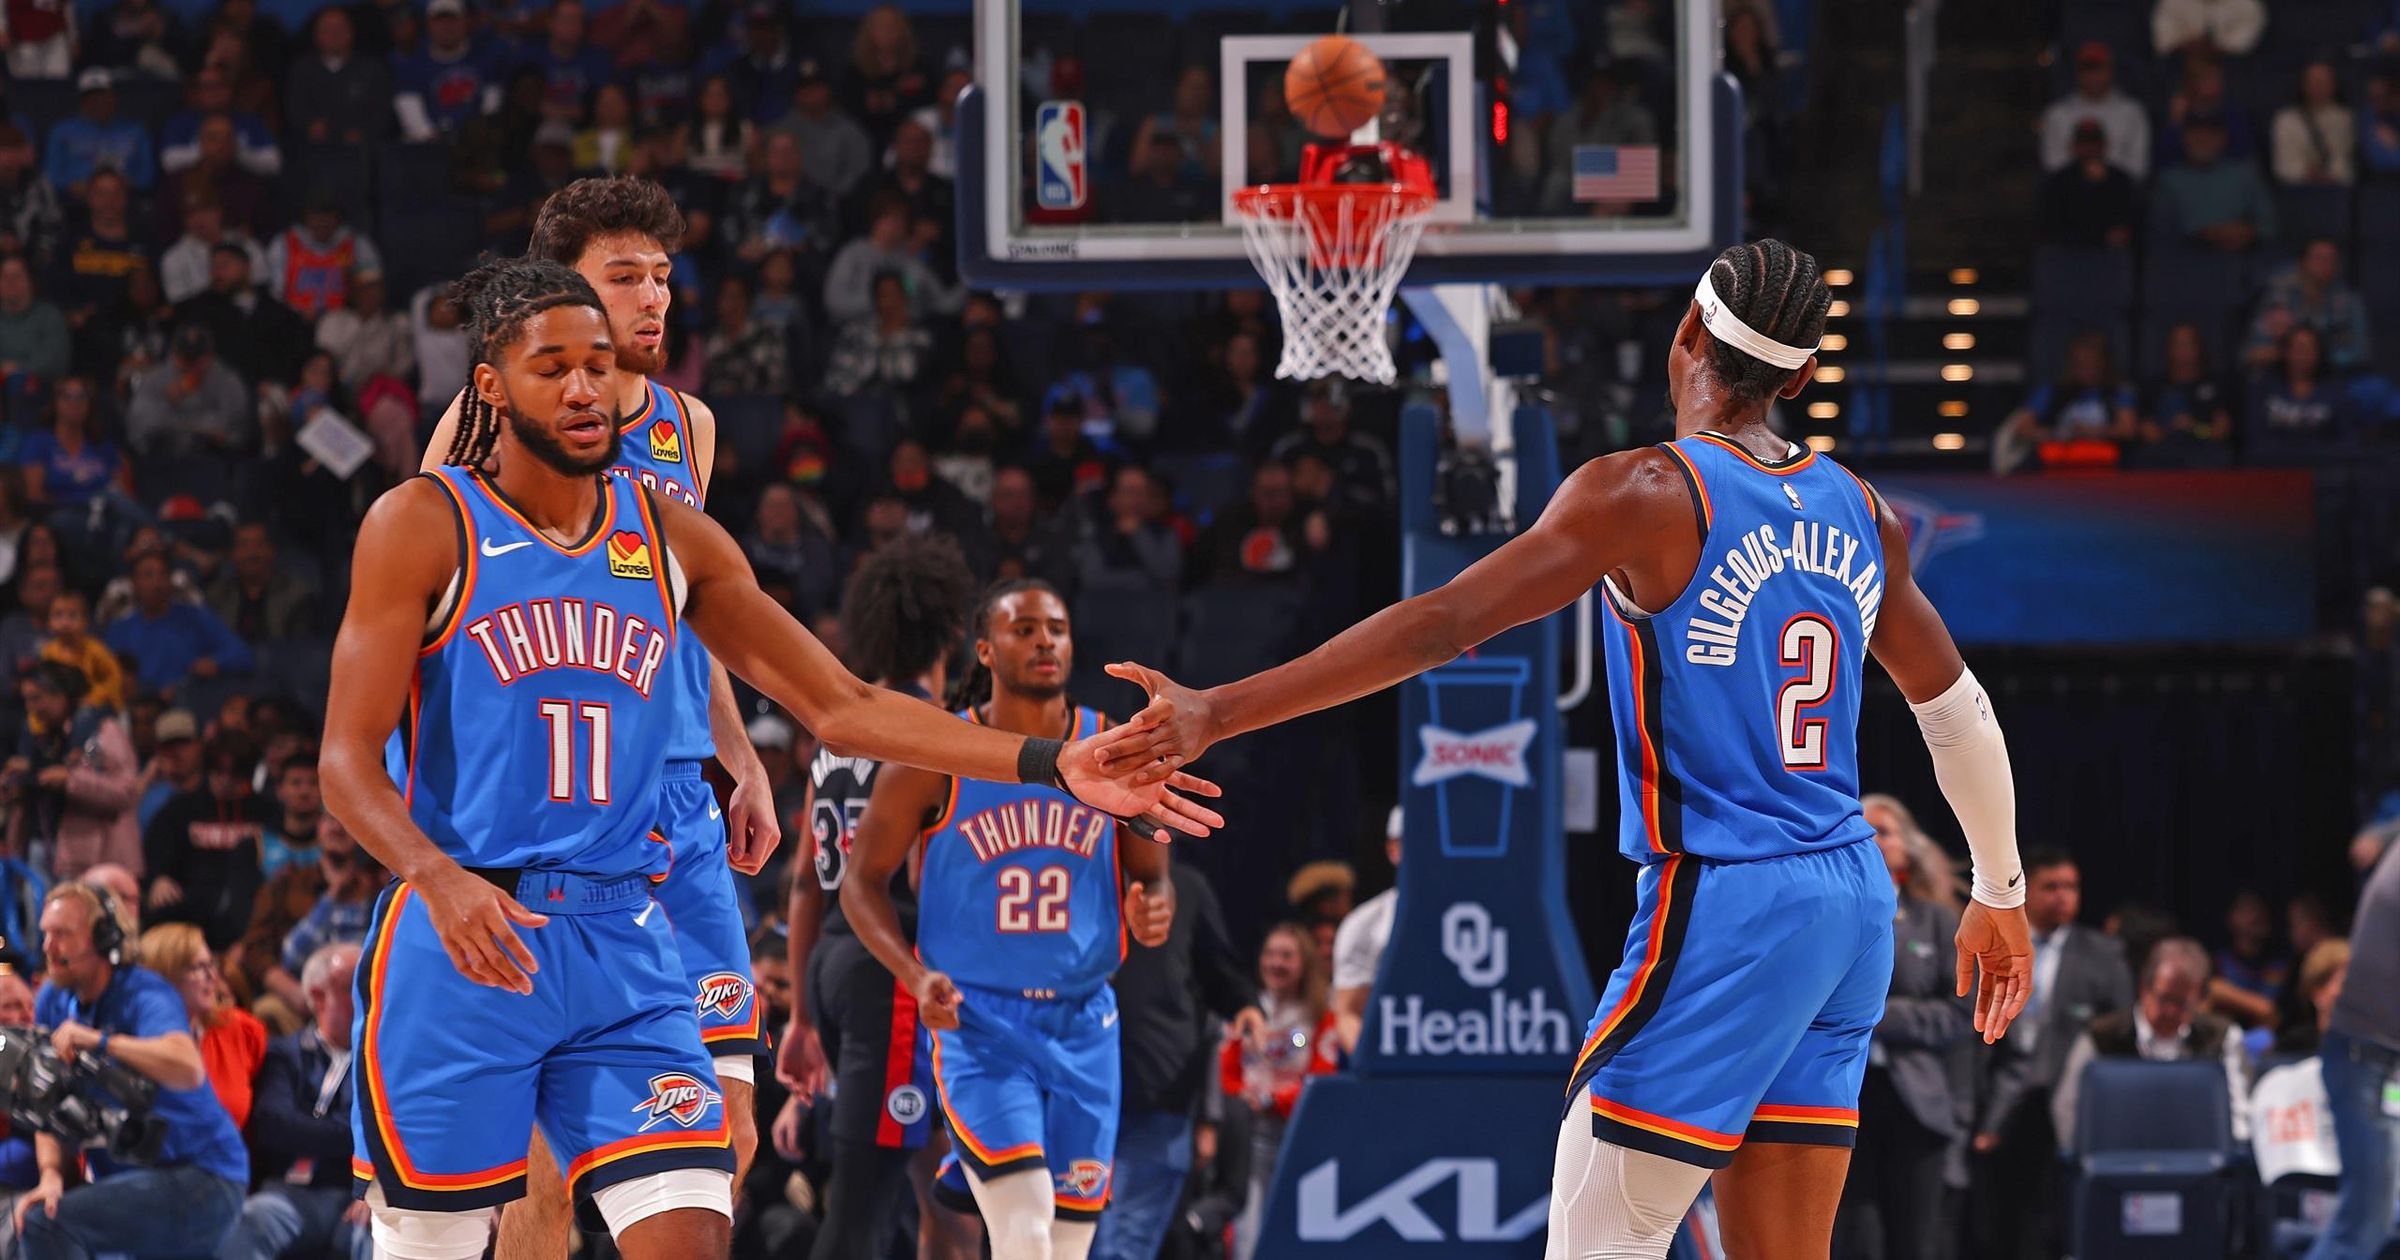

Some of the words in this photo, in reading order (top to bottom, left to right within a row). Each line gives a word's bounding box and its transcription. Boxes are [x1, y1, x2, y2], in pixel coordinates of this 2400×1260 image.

[611, 558, 650, 576] Love's
[1686, 520, 1882, 667] GILGEOUS-ALEXAND
[465, 598, 667, 702] THUNDER
[1776, 611, 1839, 772] 2
[539, 698, 611, 806] 11
[1431, 741, 1515, 767] SONIC
[957, 797, 1107, 864] THUNDER
[996, 864, 1071, 934] 22
[1441, 902, 1509, 987] OU
[700, 981, 740, 1010] OKC
[1378, 987, 1571, 1056] Health
[652, 1085, 699, 1117] OKC
